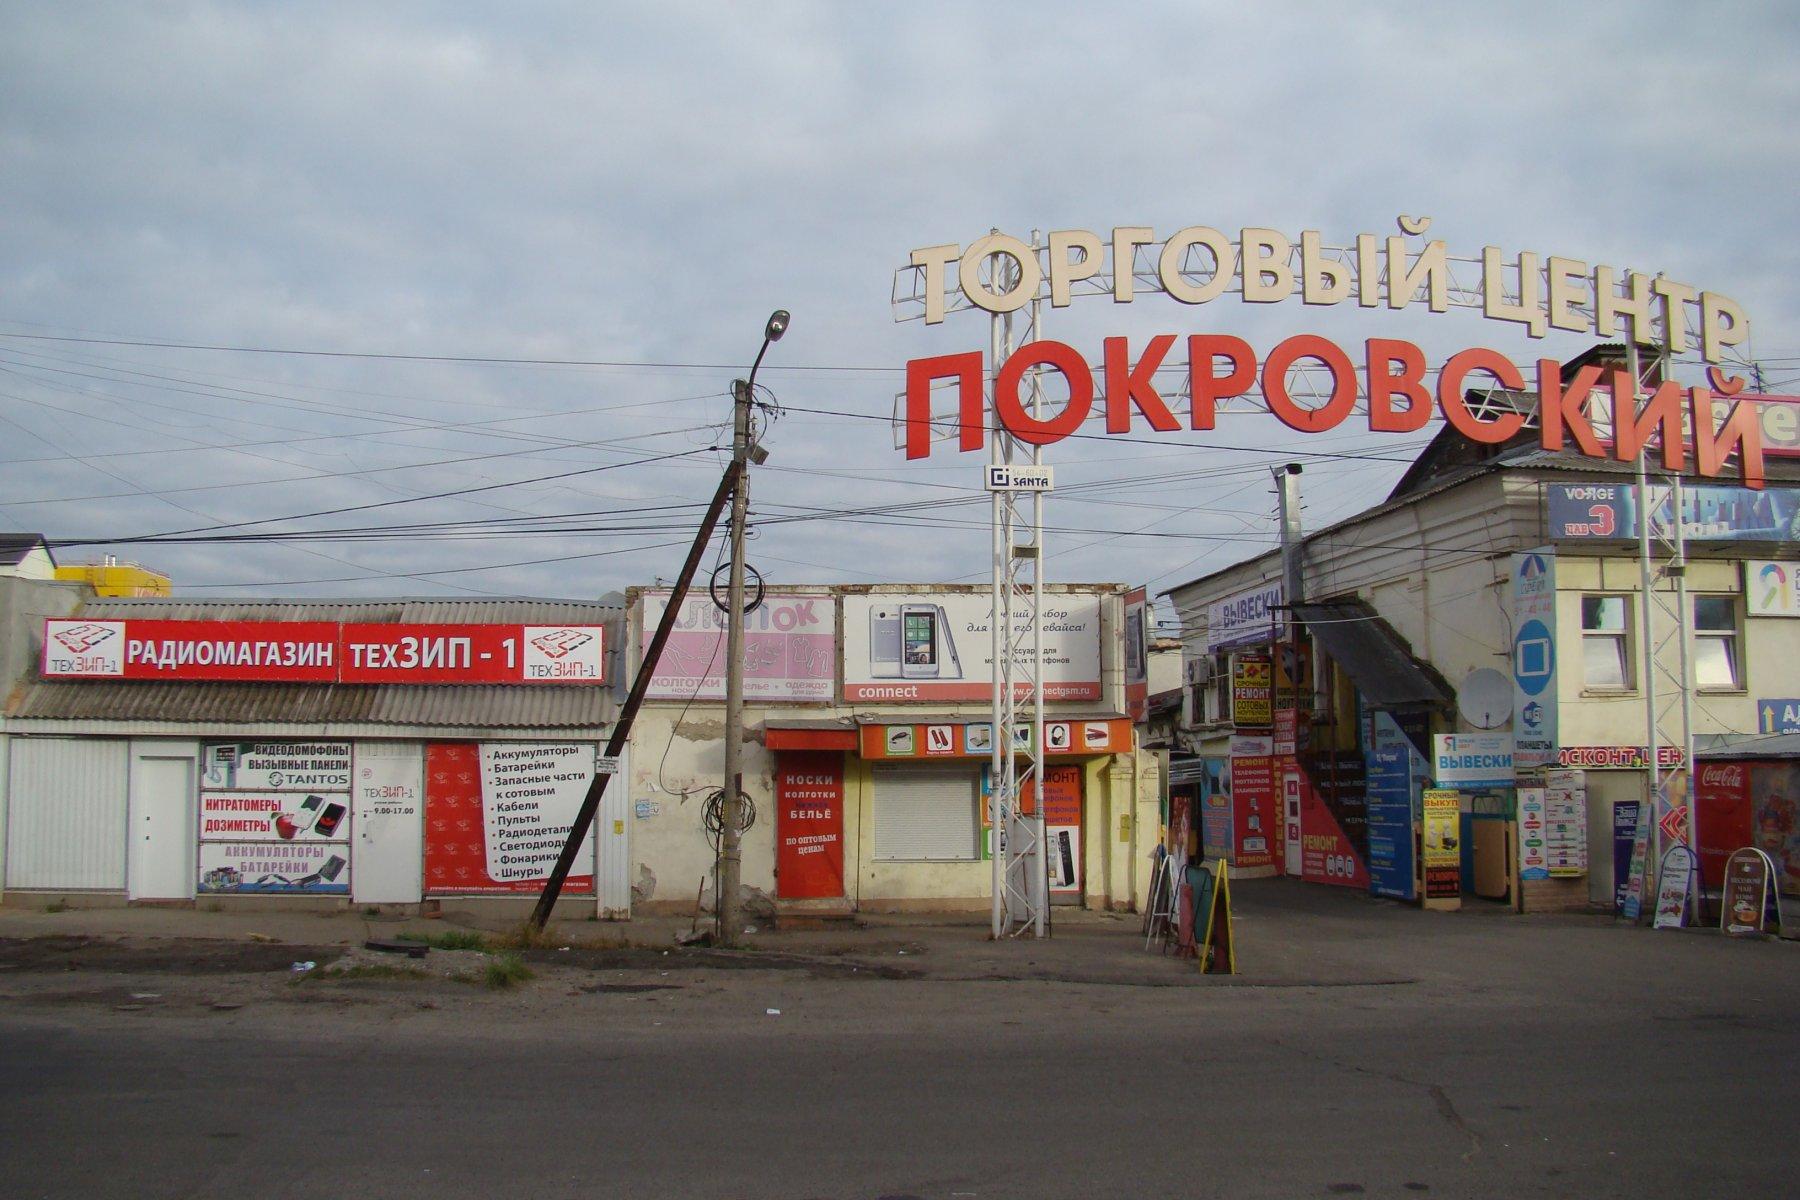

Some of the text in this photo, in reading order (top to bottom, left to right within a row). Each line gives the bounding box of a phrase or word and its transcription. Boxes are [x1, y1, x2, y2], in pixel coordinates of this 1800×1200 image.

[910, 215, 1750, 365] ТОРГОВЫЙ ЦЕНТР
[906, 334, 1765, 490] ПОКРОВСКИЙ
[1013, 477, 1049, 487] SANTA
[1589, 504, 1614, 536] 3
[966, 622, 988, 632] для
[1041, 622, 1086, 632] евайса!
[128, 639, 333, 669] РАДИОМАГАЗИН
[350, 637, 471, 669] ТЕХЗИП
[502, 638, 515, 668] 1
[52, 656, 118, 673] ТЕХЗИП-1
[530, 661, 597, 677] ТЕХЗИП-1
[858, 685, 918, 698] connect
[1235, 688, 1270, 699] РЕМОНТ
[254, 744, 349, 756] ВИДЕОДОМОФОНЫ
[493, 746, 579, 760] Аккумуляторы
[249, 759, 349, 770] ВЫЗЫВНЫЕ ПАНЕЛИ
[494, 761, 556, 774] Батарейки
[1233, 758, 1270, 767] РЕМОНТ
[1439, 754, 1513, 769] ВЫВЕСКИ
[286, 774, 348, 785] TANTOS
[495, 771, 586, 787] Запасные части
[786, 775, 833, 785] НОСКИ
[364, 786, 414, 799] ТЕХЗИП-1
[496, 787, 556, 799] к сотовым
[205, 799, 282, 811] НИТРАТОМЕРЫ
[497, 801, 539, 812] Кабели
[1424, 799, 1458, 807] ВЫКУП
[374, 807, 414, 815] 9.00-17.00
[790, 808, 831, 819] БЕЛЬЁ
[205, 819, 270, 833] ДОЗИМЕТРЫ
[497, 815, 541, 827] Пульты
[498, 825, 574, 839] Радиодетали
[1303, 835, 1338, 851] РЕМОНТ
[225, 846, 324, 858] АККУМУЛЯТОРЫ
[500, 853, 560, 866] Фонарики
[1238, 855, 1272, 865] РЕМОНТ
[240, 861, 309, 874] БАТАРЕЙКИ
[501, 866, 544, 879] Шнуры
